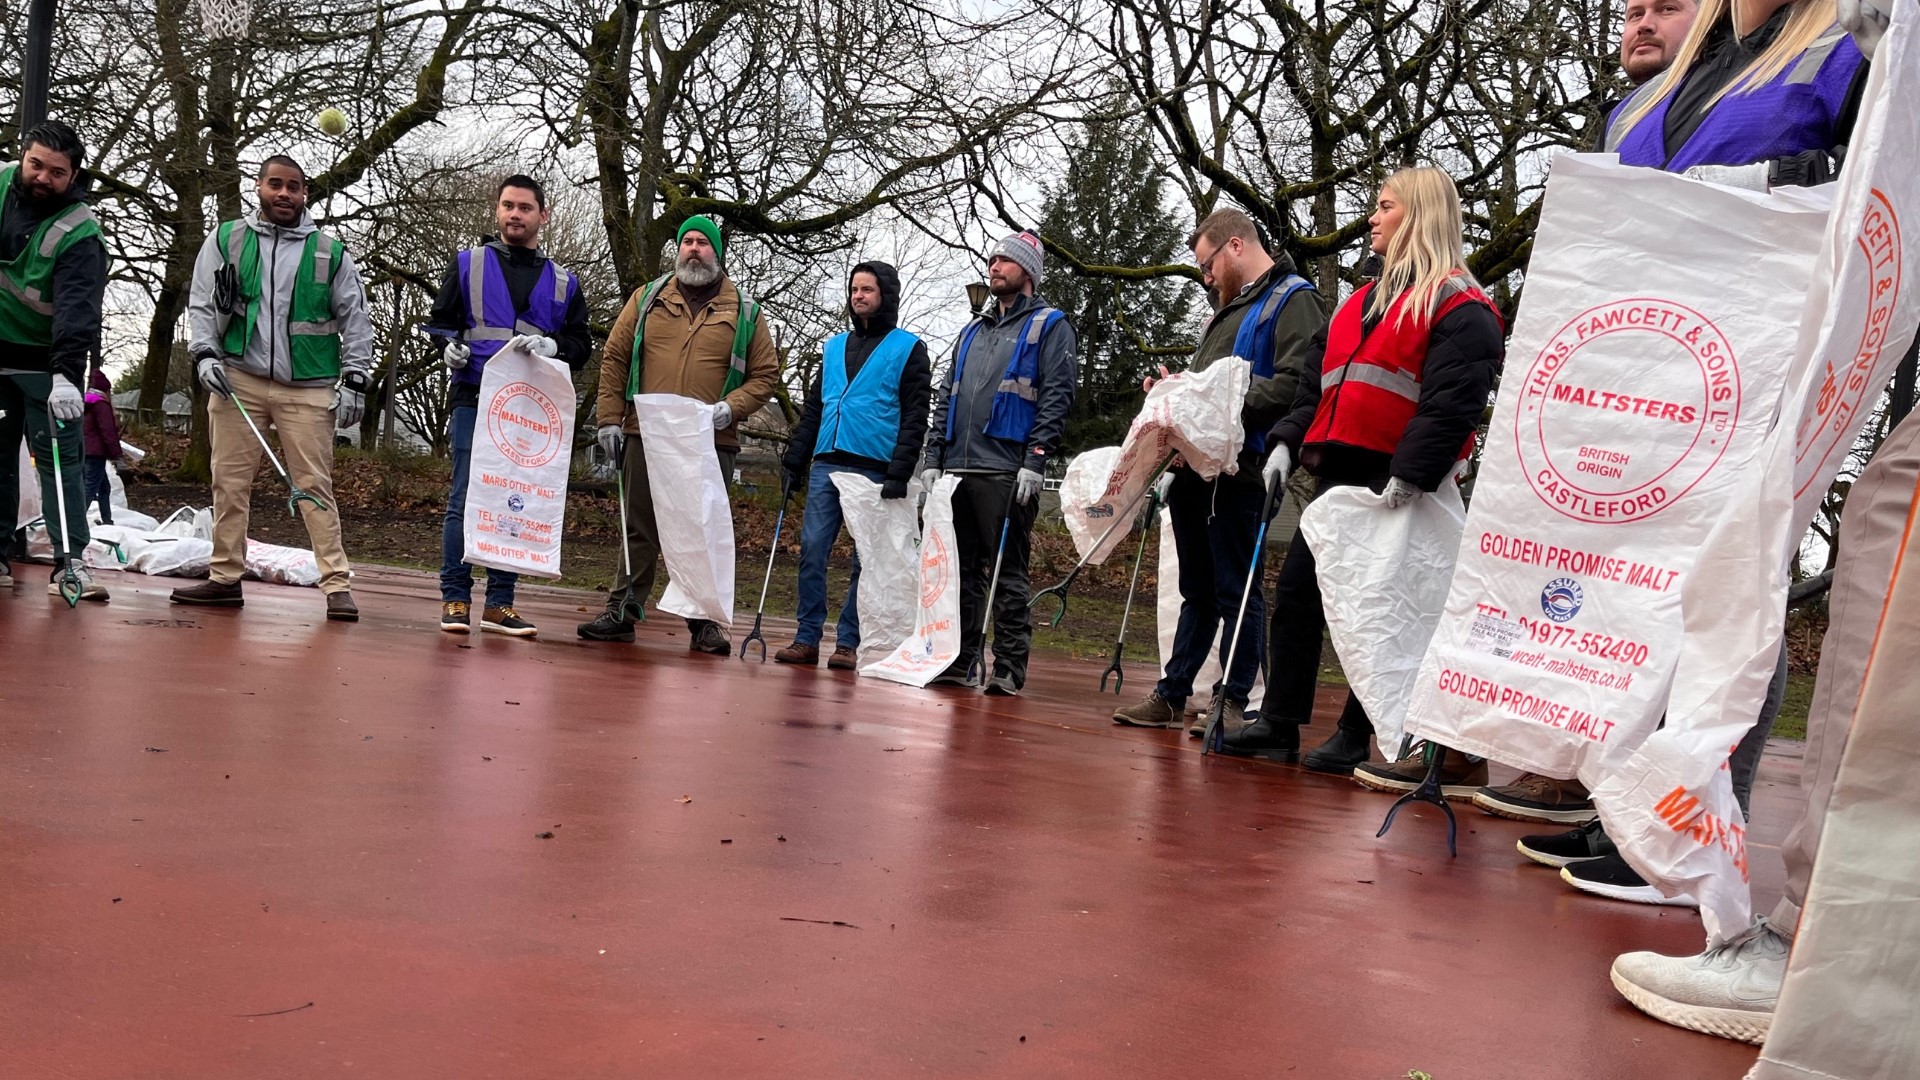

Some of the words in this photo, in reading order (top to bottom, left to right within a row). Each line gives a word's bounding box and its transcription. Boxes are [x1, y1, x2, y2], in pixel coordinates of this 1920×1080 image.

[1876, 276, 1892, 301] &
[1575, 307, 1687, 340] FAWCETT
[1685, 326, 1703, 345] &
[1850, 305, 1887, 392] SONS
[1528, 341, 1575, 398] THOS.
[1700, 341, 1732, 403] SONS
[505, 385, 537, 398] FAWCETT
[543, 402, 559, 425] SONS
[1553, 384, 1697, 425] MALTSTERS
[501, 411, 549, 435] MALTSTERS
[1710, 411, 1729, 432] LTD
[500, 443, 547, 465] CASTLEFORD
[1578, 446, 1630, 465] BRITISH
[1577, 461, 1623, 479] ORIGIN
[482, 474, 507, 488] MARIS
[537, 488, 555, 500] MALT
[1537, 469, 1667, 518] CASTLEFORD
[478, 510, 494, 522] TEL
[477, 541, 500, 555] MARIS
[530, 553, 550, 564] MALT
[1480, 532, 1544, 566] GOLDEN
[1545, 546, 1627, 582] PROMISE
[1625, 562, 1679, 593] MALT
[1543, 579, 1583, 607] ASSURED
[1471, 627, 1486, 635] PALE
[1473, 621, 1497, 633] GOLDEN
[1438, 669, 1499, 702] GOLDEN
[1499, 687, 1570, 727] PROMISE
[1565, 710, 1615, 743] MALT
